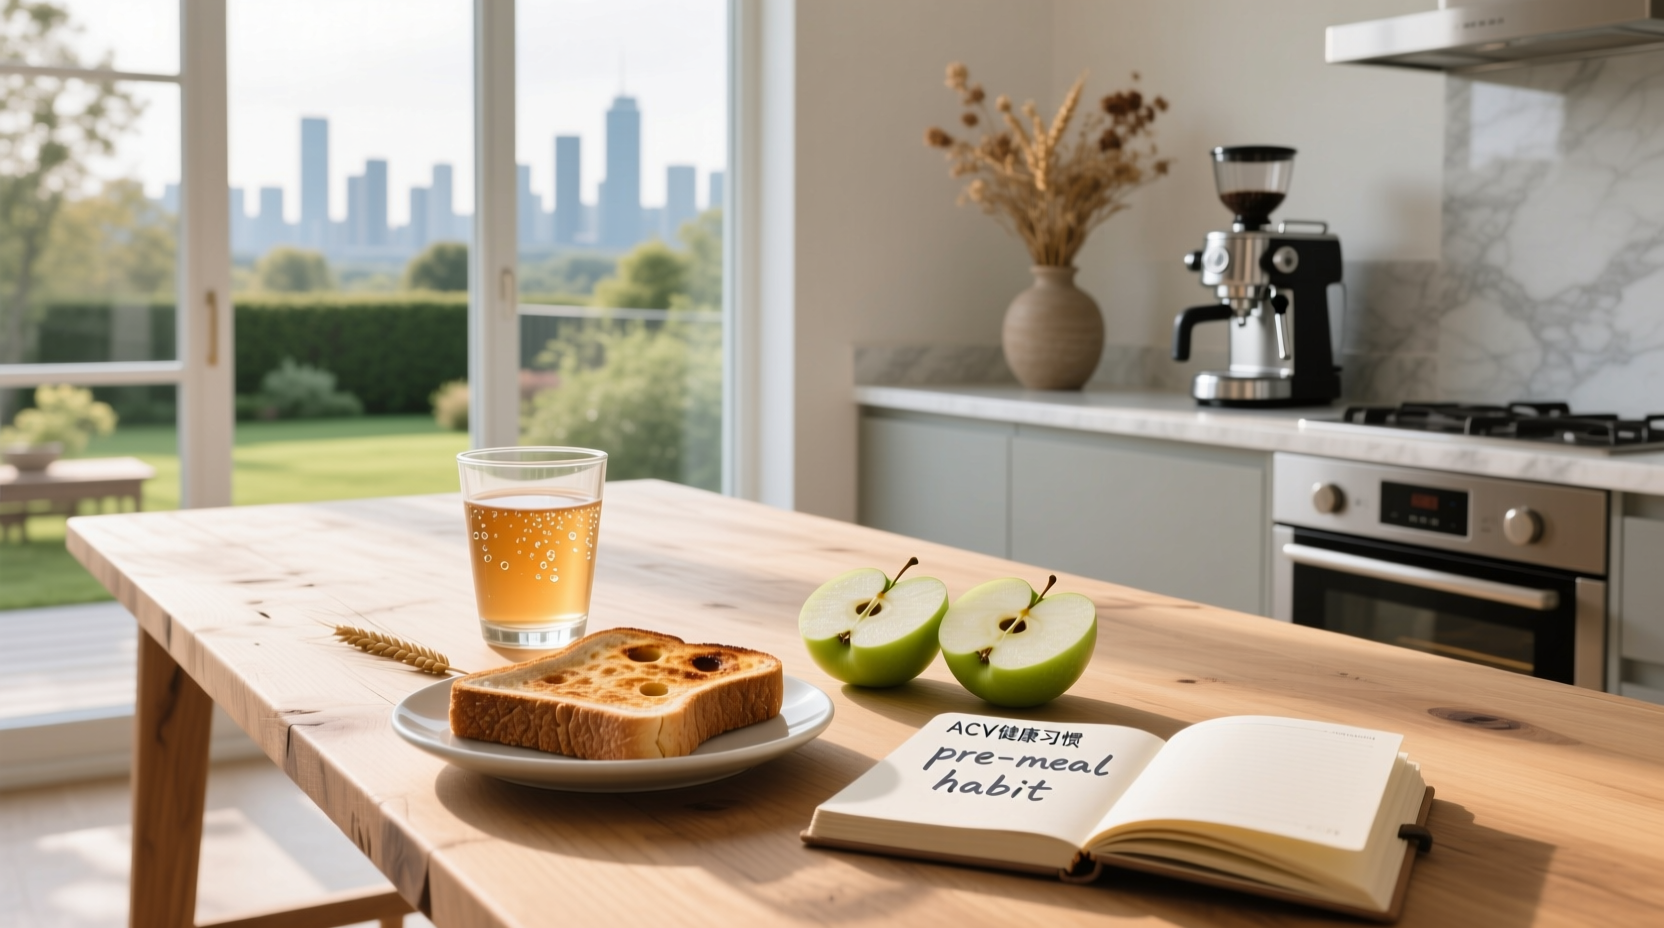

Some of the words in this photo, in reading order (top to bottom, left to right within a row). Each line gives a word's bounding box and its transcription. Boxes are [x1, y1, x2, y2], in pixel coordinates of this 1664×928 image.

[946, 721, 1083, 748] ACV健康习惯
[923, 746, 1113, 776] pre-meal
[932, 769, 1053, 801] habit
